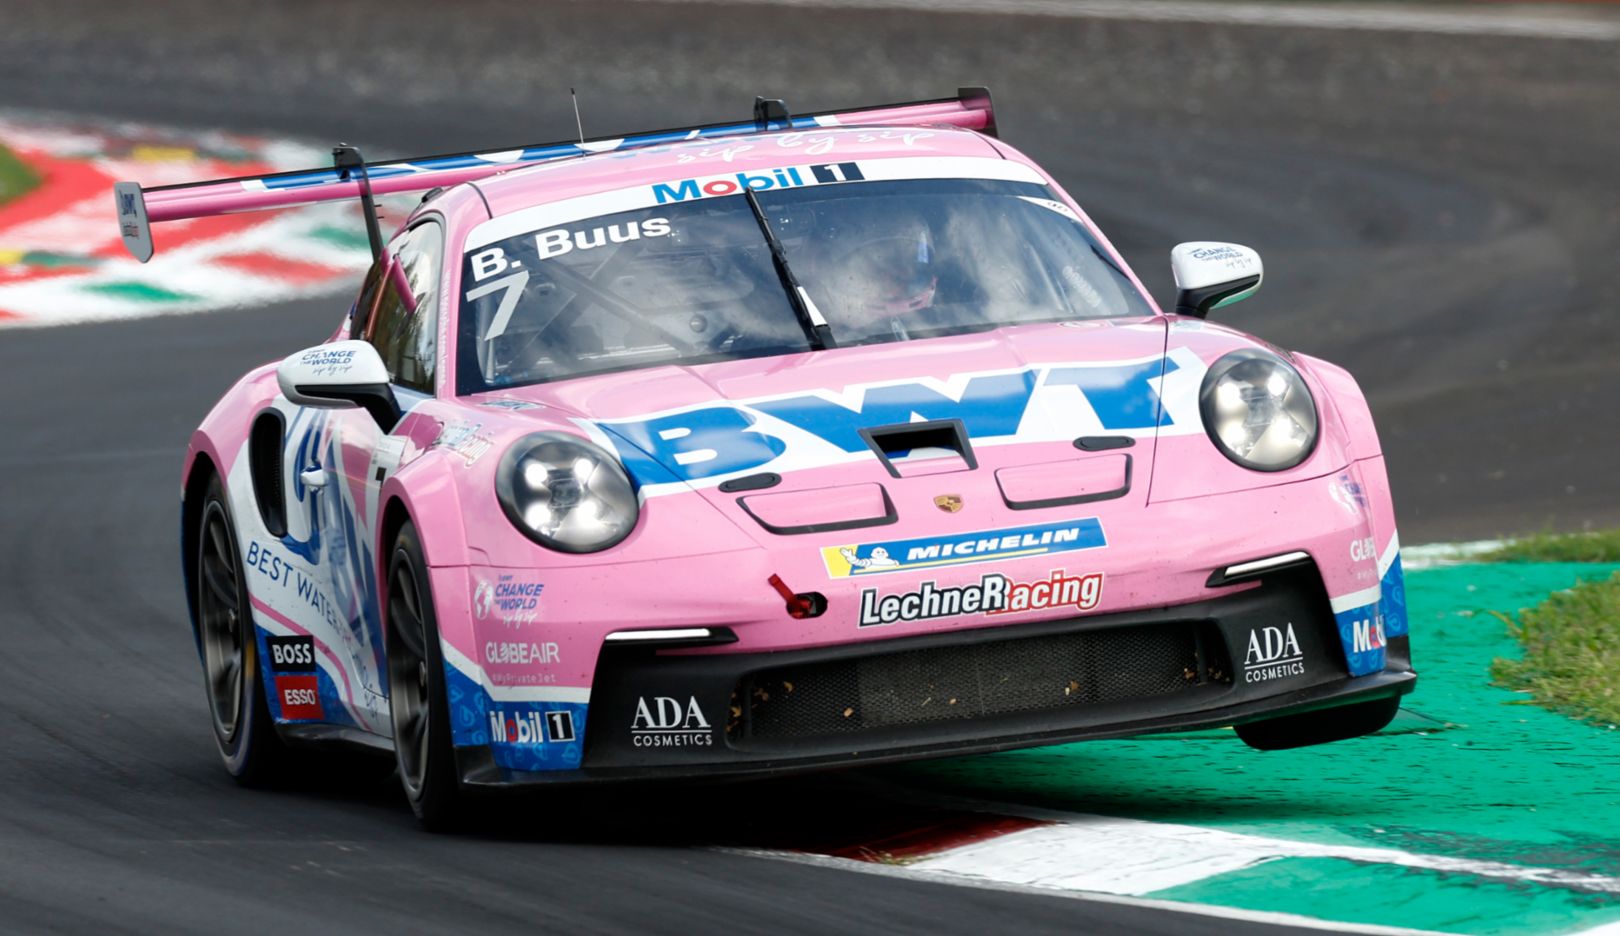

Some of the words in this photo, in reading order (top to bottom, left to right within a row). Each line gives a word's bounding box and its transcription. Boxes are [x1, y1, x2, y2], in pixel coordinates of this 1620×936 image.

[651, 166, 804, 204] Mobil
[470, 246, 521, 282] B.
[534, 217, 671, 260] Buus
[466, 270, 530, 341] 7
[597, 355, 1181, 487] BWT
[906, 527, 1079, 560] MICHELIN
[246, 541, 293, 588] BEST
[495, 583, 544, 598] CHANGE
[500, 598, 537, 611] WORLD
[271, 642, 312, 665] BOSS
[485, 641, 560, 664] GLOBEAIR
[1244, 621, 1303, 665] ADA
[1245, 662, 1304, 684] COSMETICS
[284, 688, 316, 705] ESSO
[630, 695, 711, 729] ADA
[489, 710, 543, 744] Mobil
[633, 734, 712, 747] COSMETICS
